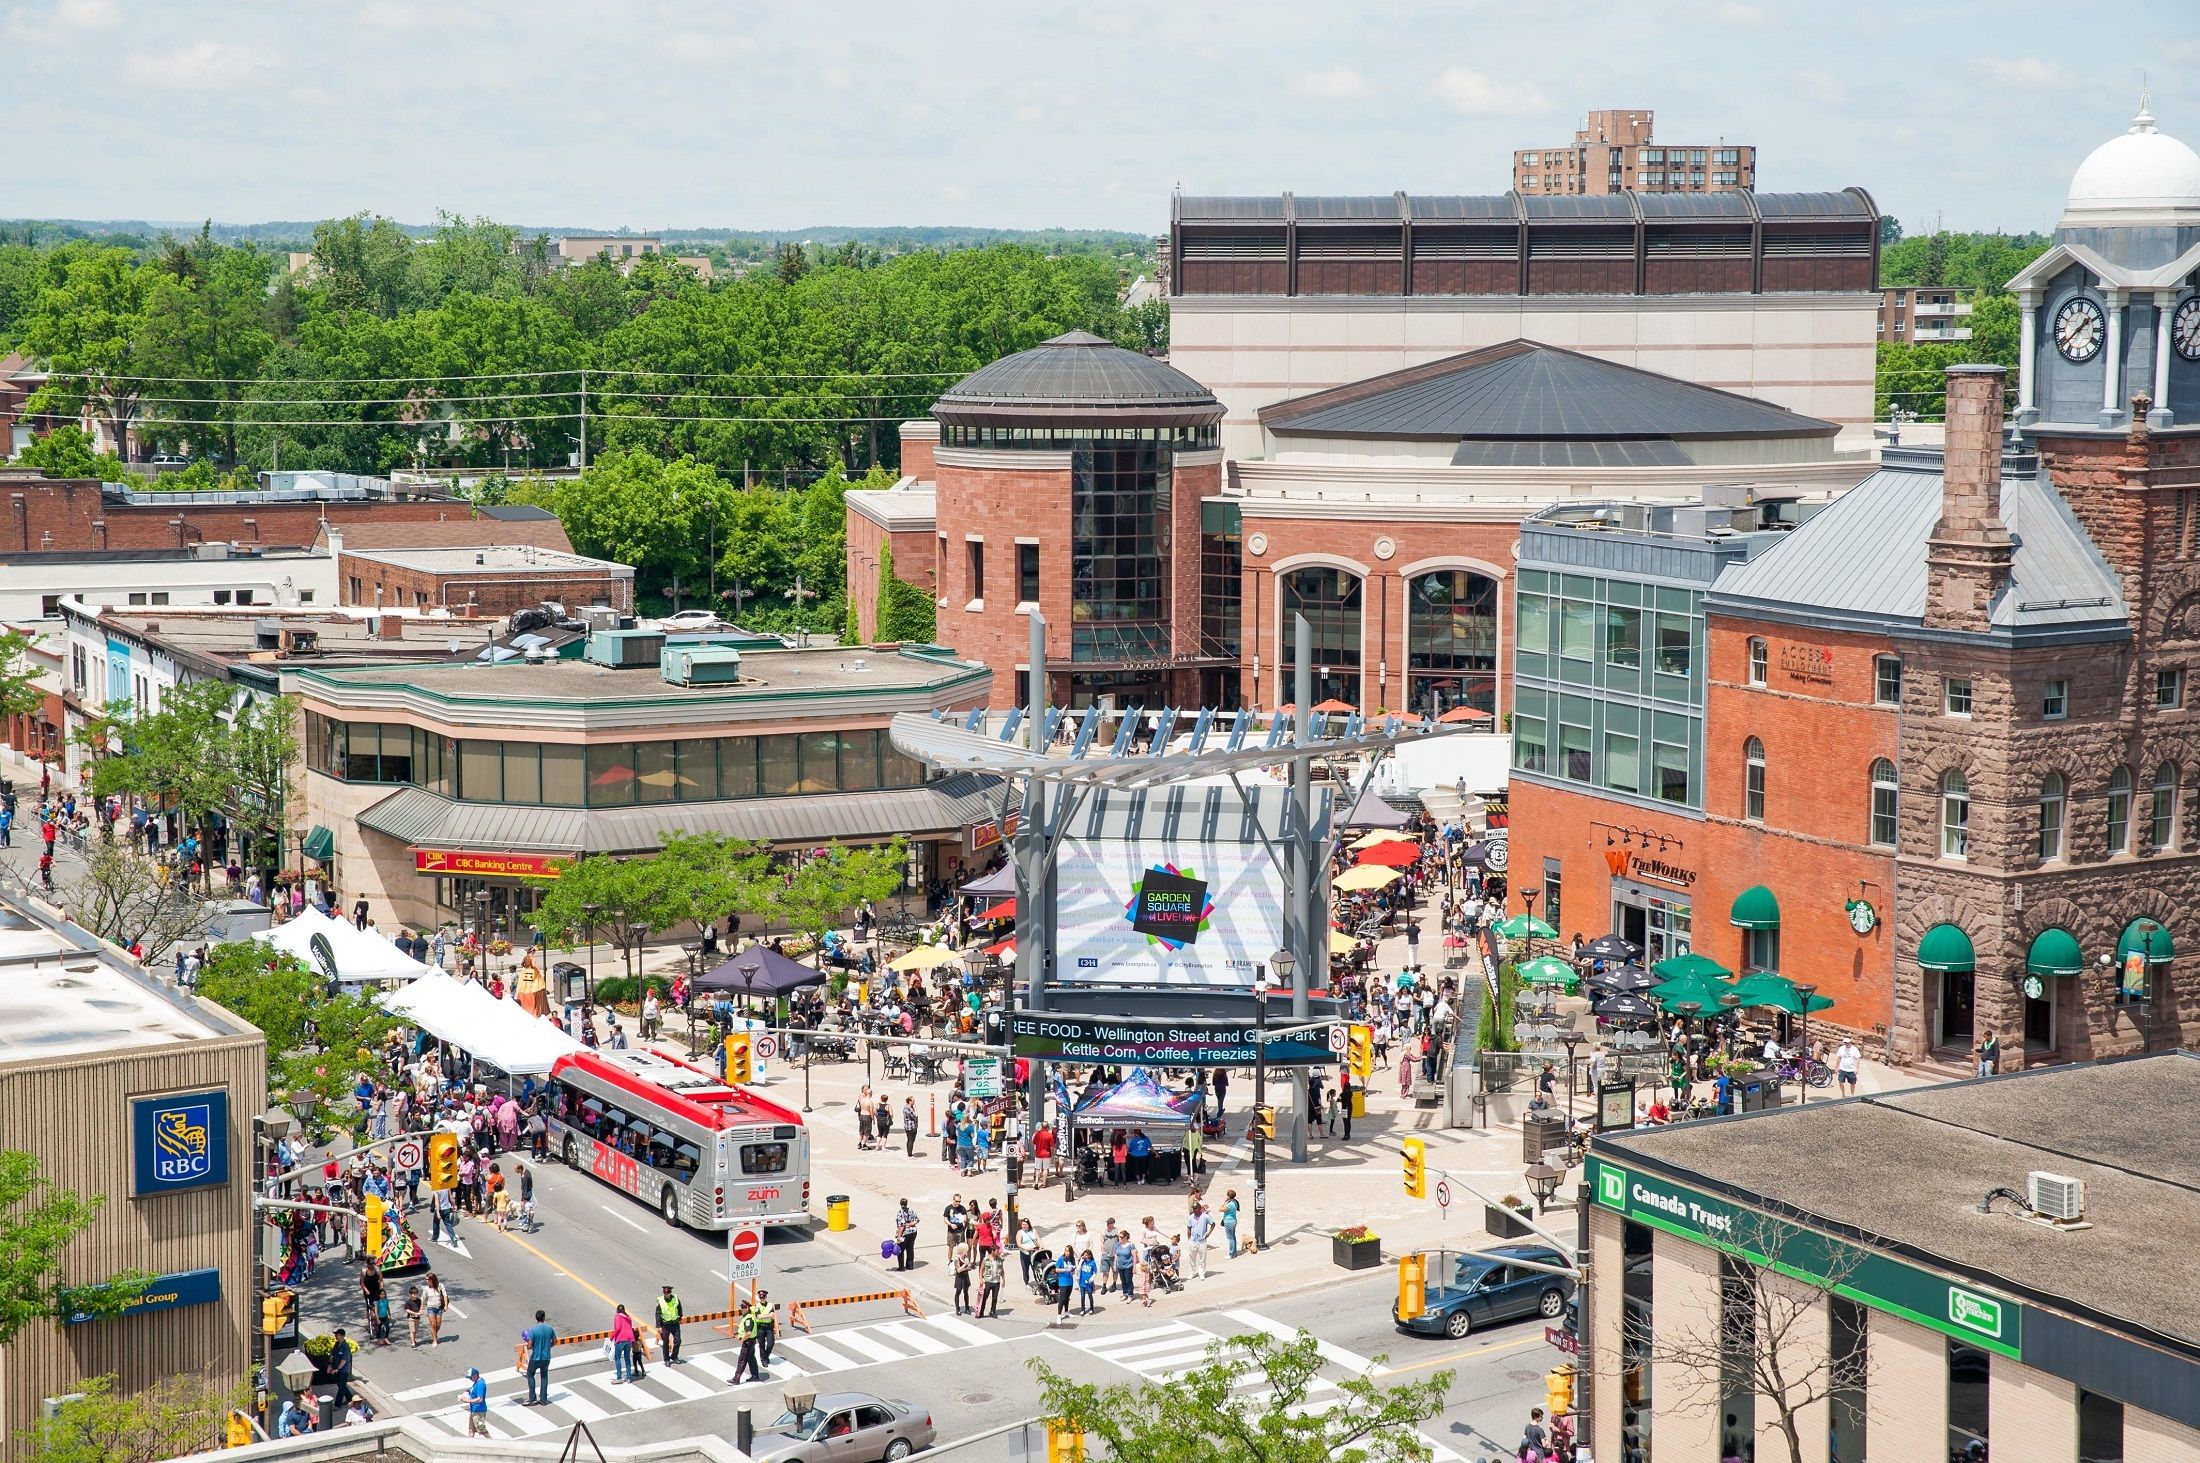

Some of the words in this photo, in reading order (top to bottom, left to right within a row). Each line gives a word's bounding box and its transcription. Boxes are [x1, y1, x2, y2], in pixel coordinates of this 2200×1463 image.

[428, 852, 445, 861] CIBC
[456, 858, 474, 867] CIBC
[474, 860, 505, 871] Banking
[506, 862, 533, 871] Centre
[1147, 893, 1191, 902] GARDEN
[1147, 903, 1191, 912] SQUARE
[1000, 1020, 1036, 1035] FREE
[1040, 1023, 1081, 1037] FOOD
[1094, 1027, 1165, 1044] Wellington
[1168, 1029, 1206, 1043] Street
[1213, 1030, 1240, 1043] and
[1244, 1030, 1281, 1044] Gge
[1062, 1042, 1099, 1056] Kettle
[1104, 1045, 1140, 1060] Corn,
[1145, 1046, 1193, 1060] Coffee,
[1199, 1048, 1257, 1060] Freezies
[986, 1103, 1000, 1114] QUEEN
[1000, 1100, 1005, 1110] ST
[1005, 1099, 1008, 1108] E
[1056, 1112, 1067, 1156] Festivals
[161, 1156, 204, 1176] RBC
[1602, 1172, 1622, 1201] TD
[1632, 1184, 1686, 1217] Canada
[1689, 1202, 1732, 1233] Trust
[732, 1269, 758, 1278] CLOSED
[736, 1263, 754, 1271] ROAD
[146, 1292, 178, 1304] Group
[1551, 1333, 1562, 1346] MAIN
[1562, 1338, 1568, 1348] ST
[1570, 1342, 1573, 1351] S
